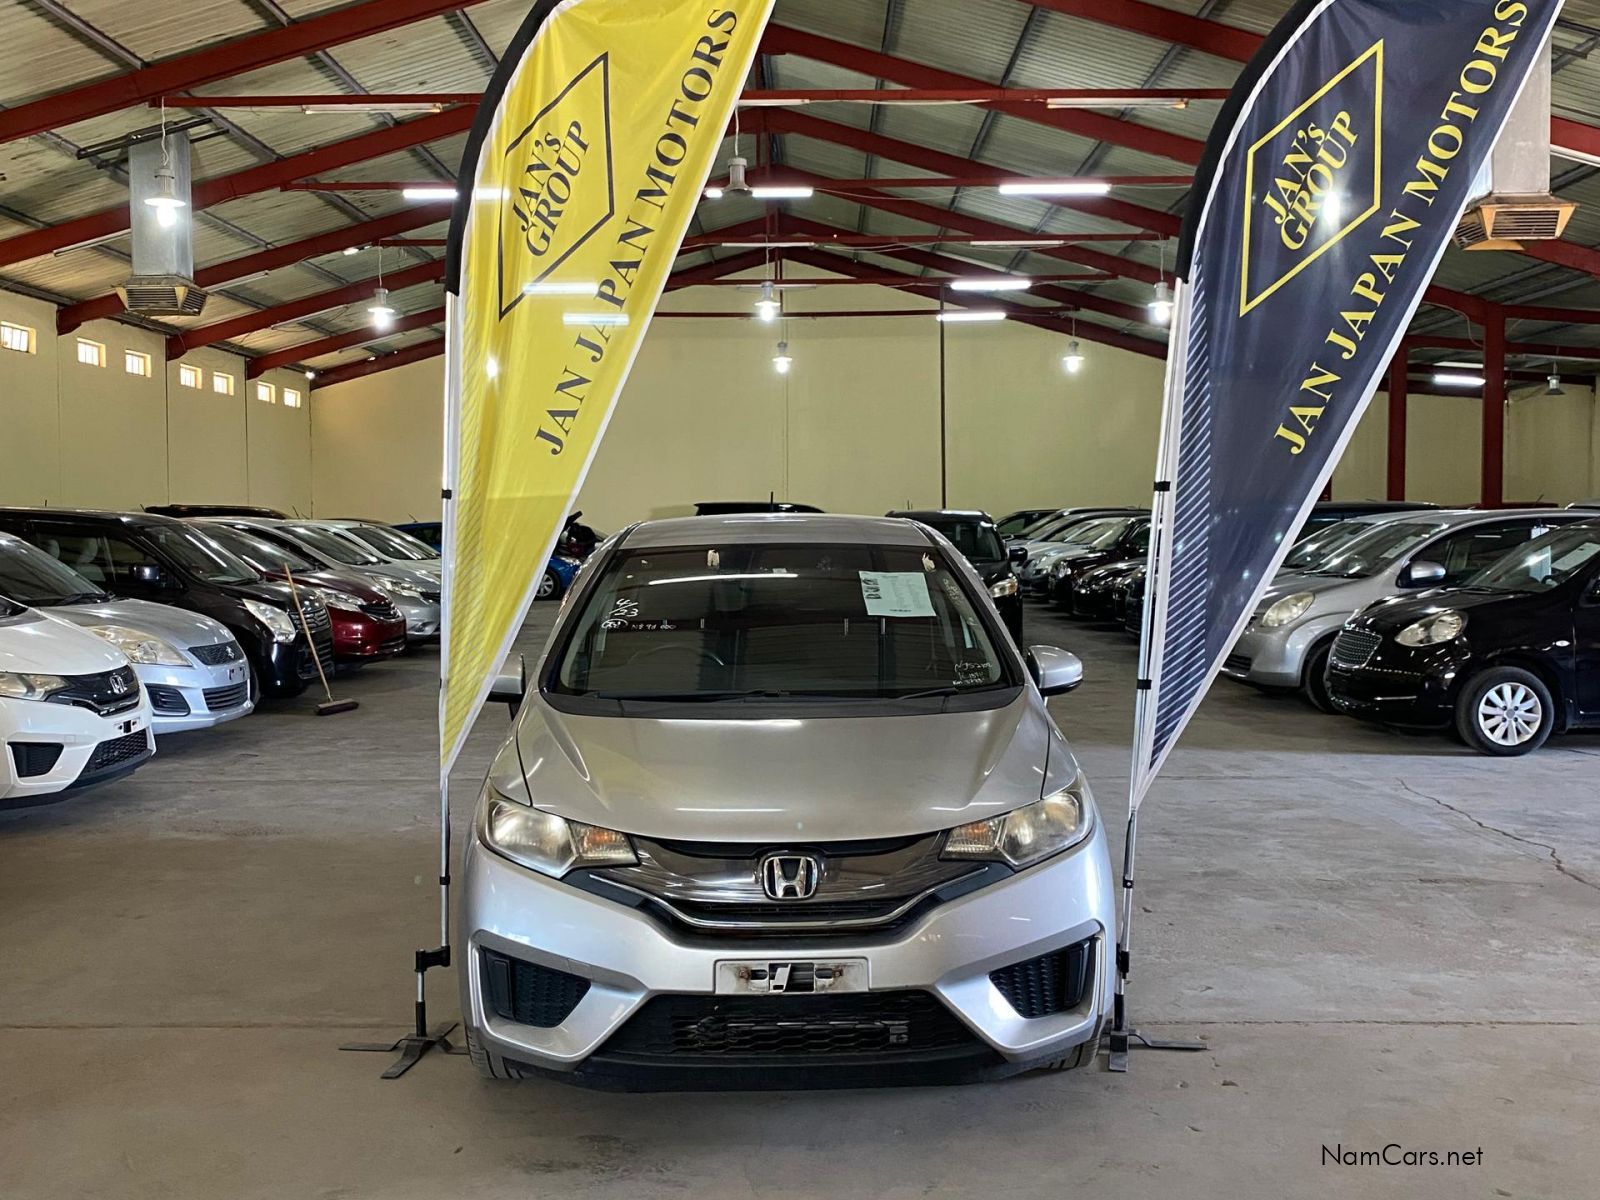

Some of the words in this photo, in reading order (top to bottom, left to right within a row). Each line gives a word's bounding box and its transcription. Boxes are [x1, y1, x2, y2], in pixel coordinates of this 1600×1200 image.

[526, 119, 590, 258] GROUP
[534, 365, 592, 457] JAN
[635, 9, 738, 212] MOTORS
[1274, 361, 1342, 456] JAN
[1325, 208, 1422, 360] JAPAN
[1402, 0, 1528, 207] MOTORS
[1280, 110, 1358, 251] GROUP
